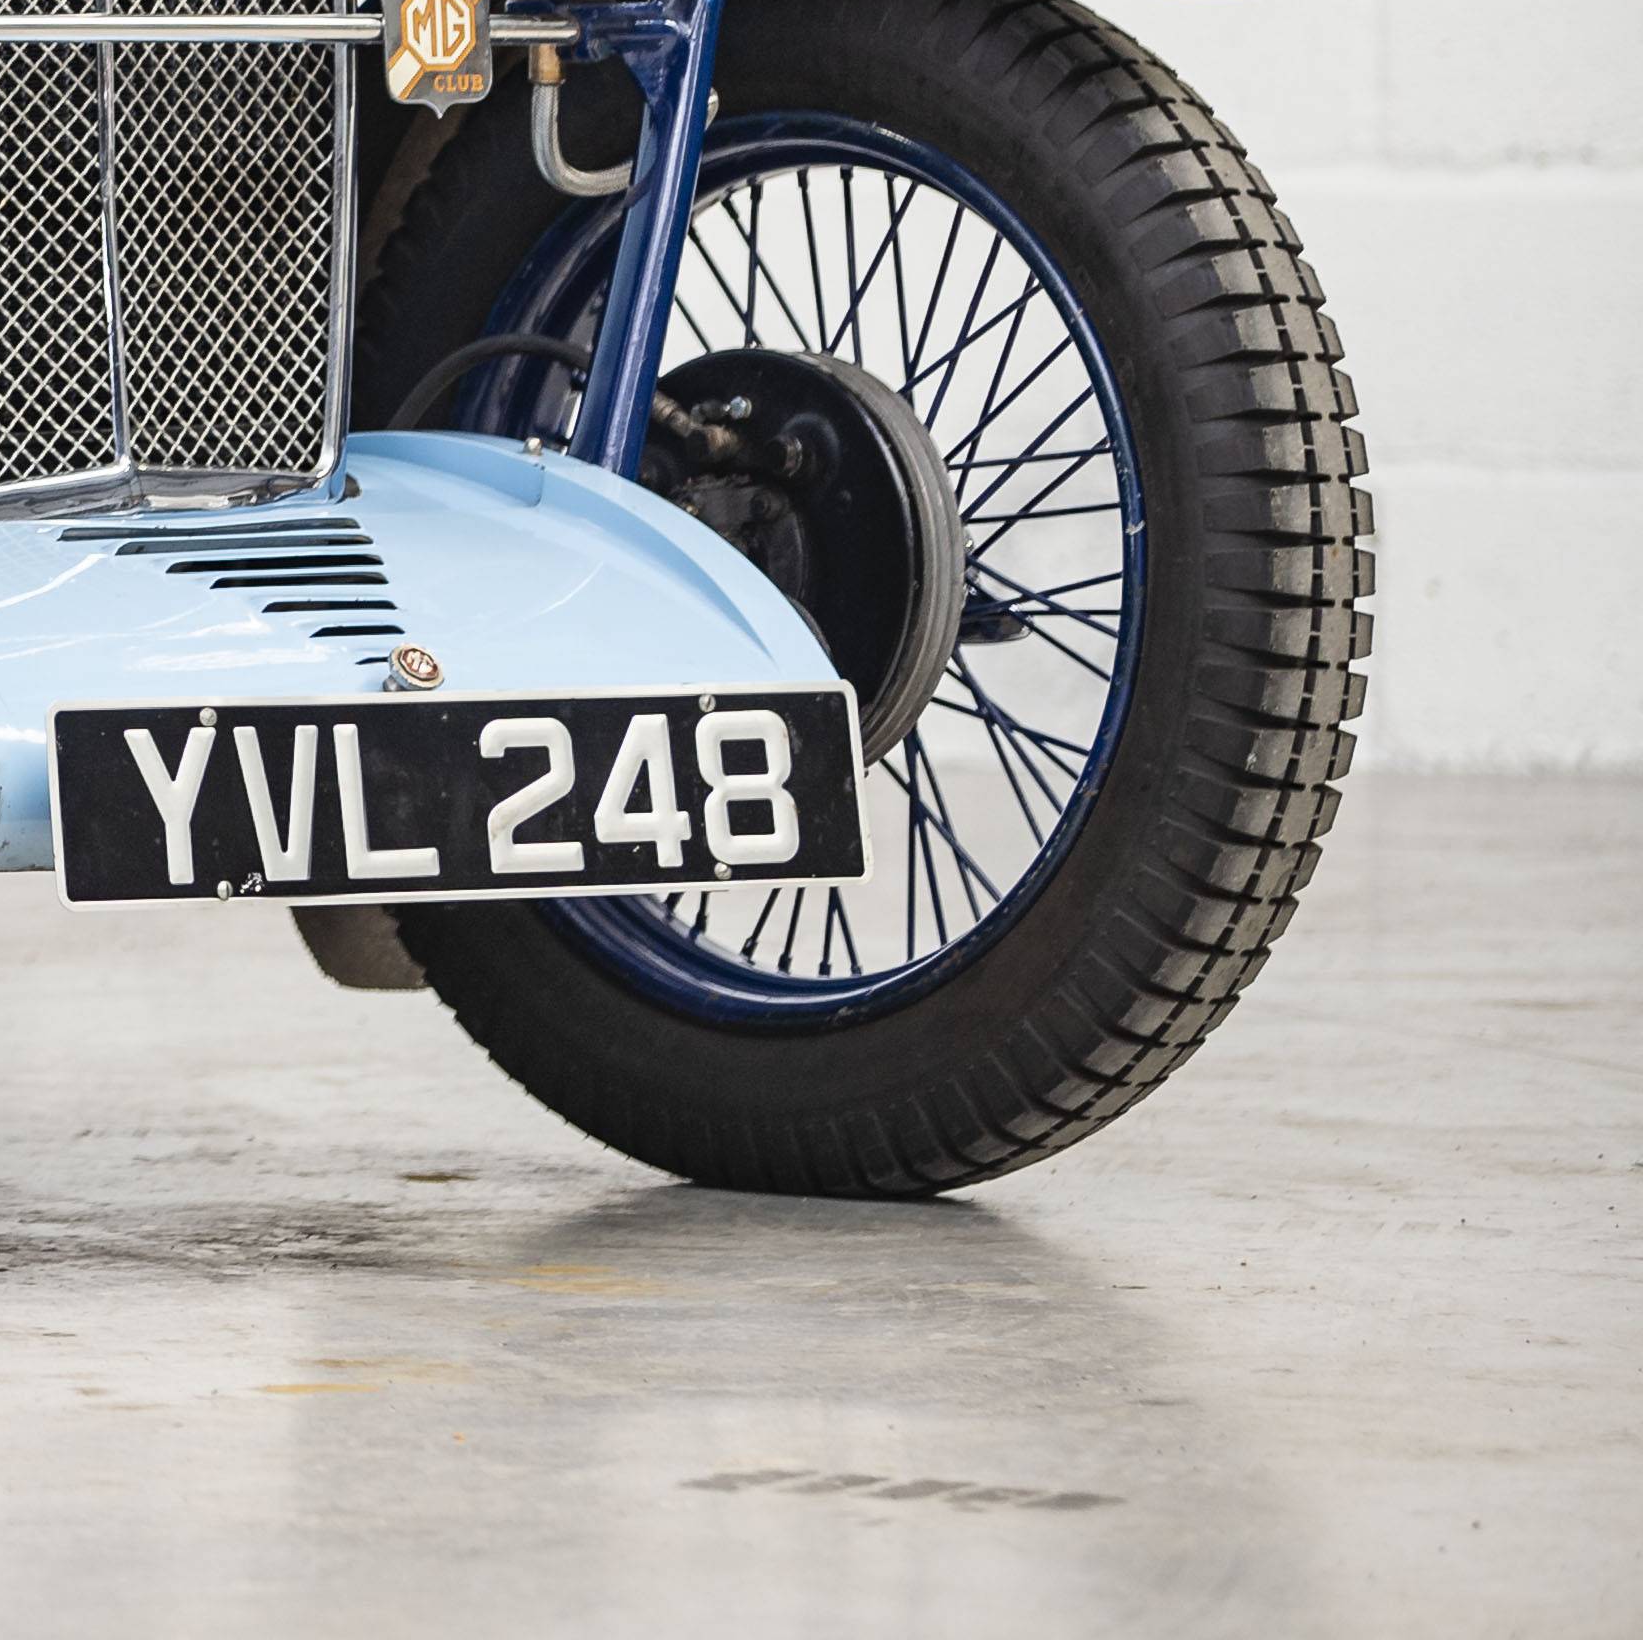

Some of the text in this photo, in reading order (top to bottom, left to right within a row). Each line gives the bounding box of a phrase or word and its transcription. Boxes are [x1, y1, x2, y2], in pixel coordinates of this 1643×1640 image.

[434, 74, 484, 93] CLUB
[123, 709, 801, 885] YVL 248
